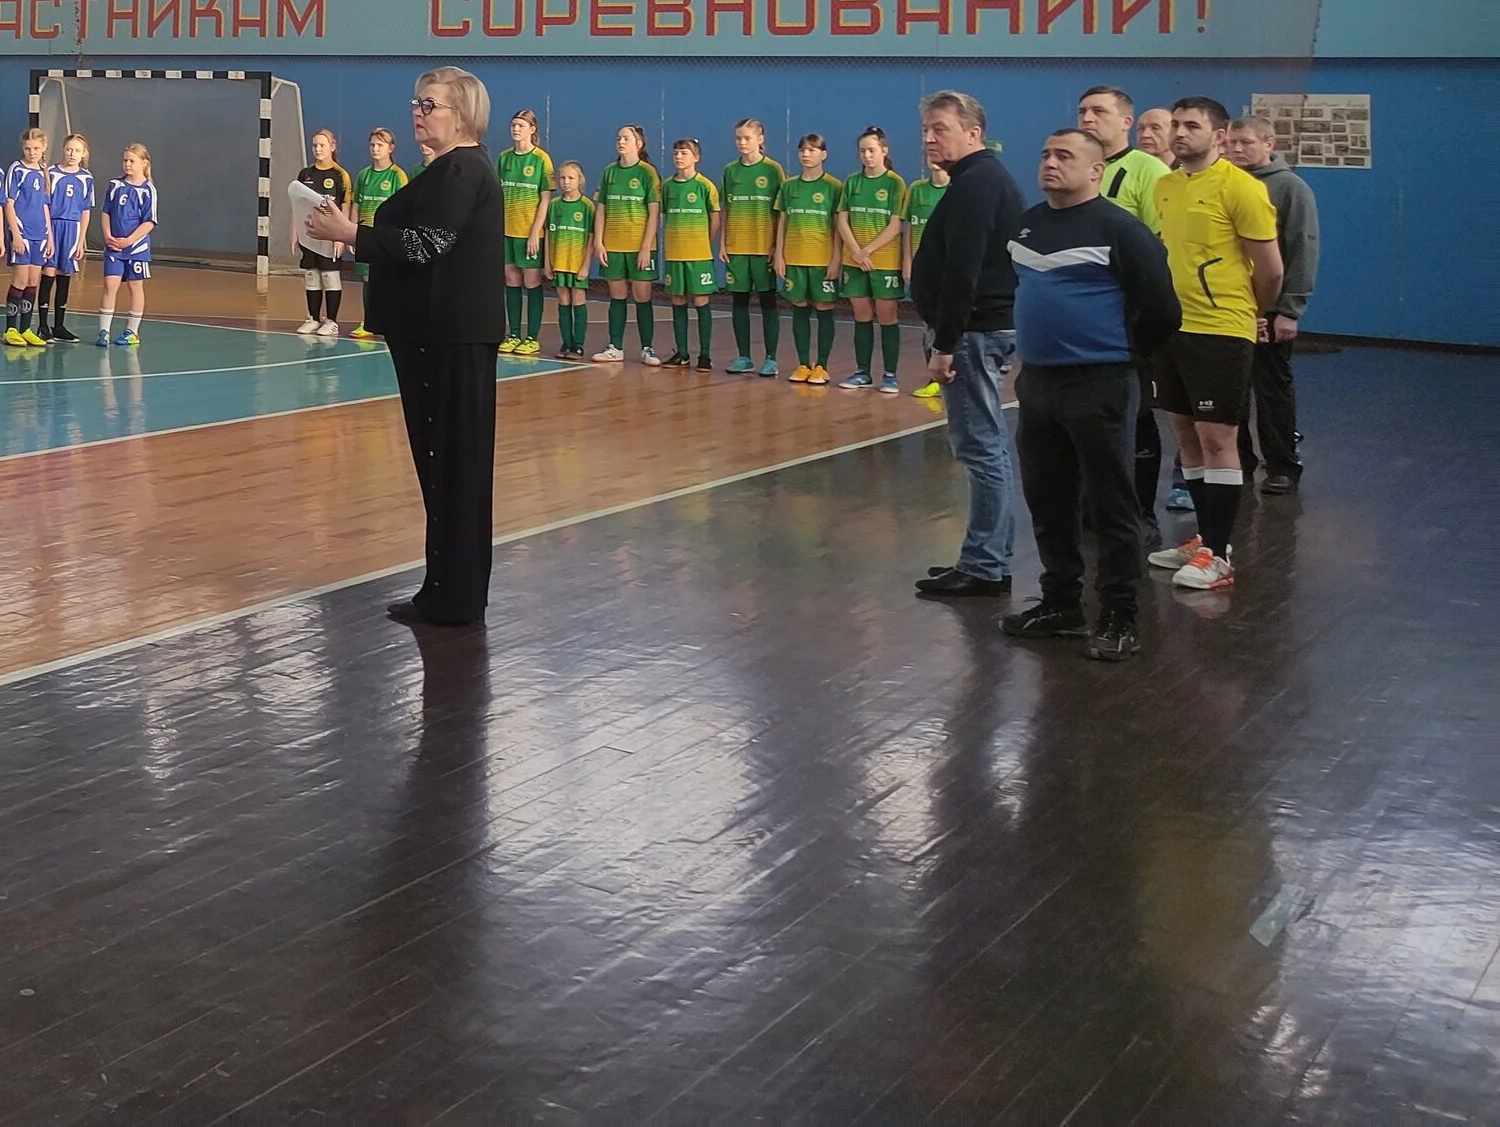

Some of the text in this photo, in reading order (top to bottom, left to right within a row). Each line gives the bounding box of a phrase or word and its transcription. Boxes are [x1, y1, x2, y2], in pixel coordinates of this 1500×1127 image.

[33, 178, 40, 191] 4
[66, 184, 74, 197] 5
[119, 194, 128, 206] 6
[133, 261, 143, 274] 6
[700, 273, 713, 286] 22
